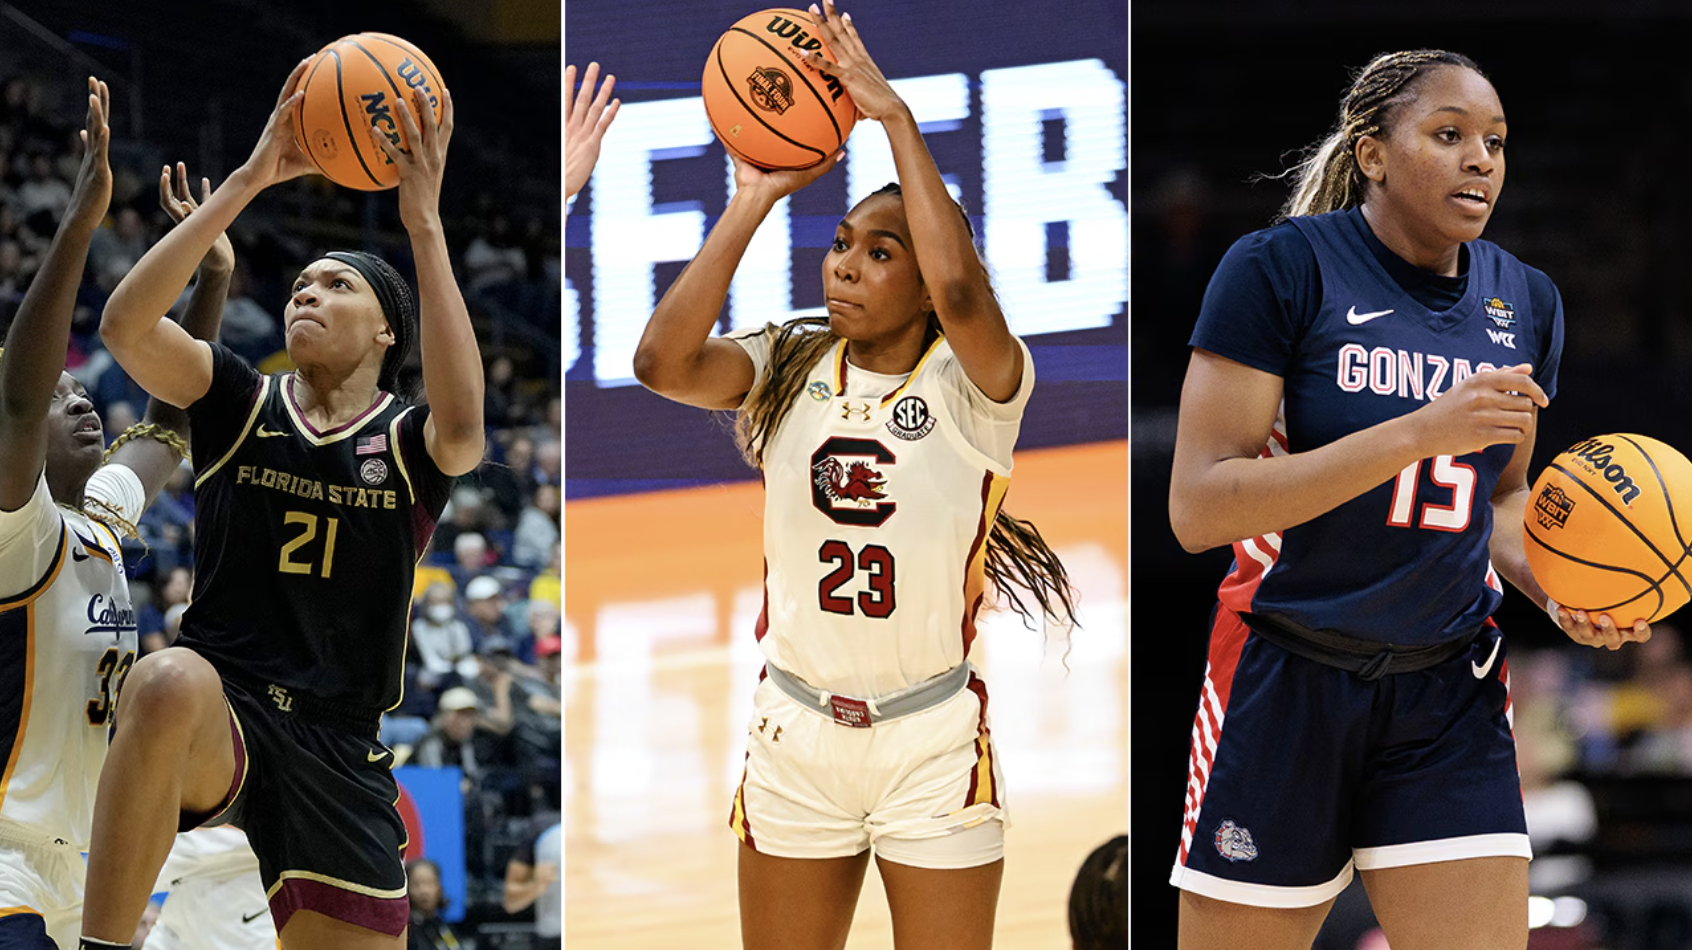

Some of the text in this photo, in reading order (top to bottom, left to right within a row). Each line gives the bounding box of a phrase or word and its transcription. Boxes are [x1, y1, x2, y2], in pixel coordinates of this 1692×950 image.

[751, 71, 791, 111] FINAL FOUR
[1337, 343, 1518, 402] GONZA
[891, 424, 930, 440] GRADUATE
[896, 398, 925, 429] SEC
[236, 465, 397, 509] FLORIDA STATE
[1386, 449, 1477, 533] 15
[1538, 495, 1569, 521] WBIT
[278, 511, 339, 578] 21
[818, 539, 896, 619] 23
